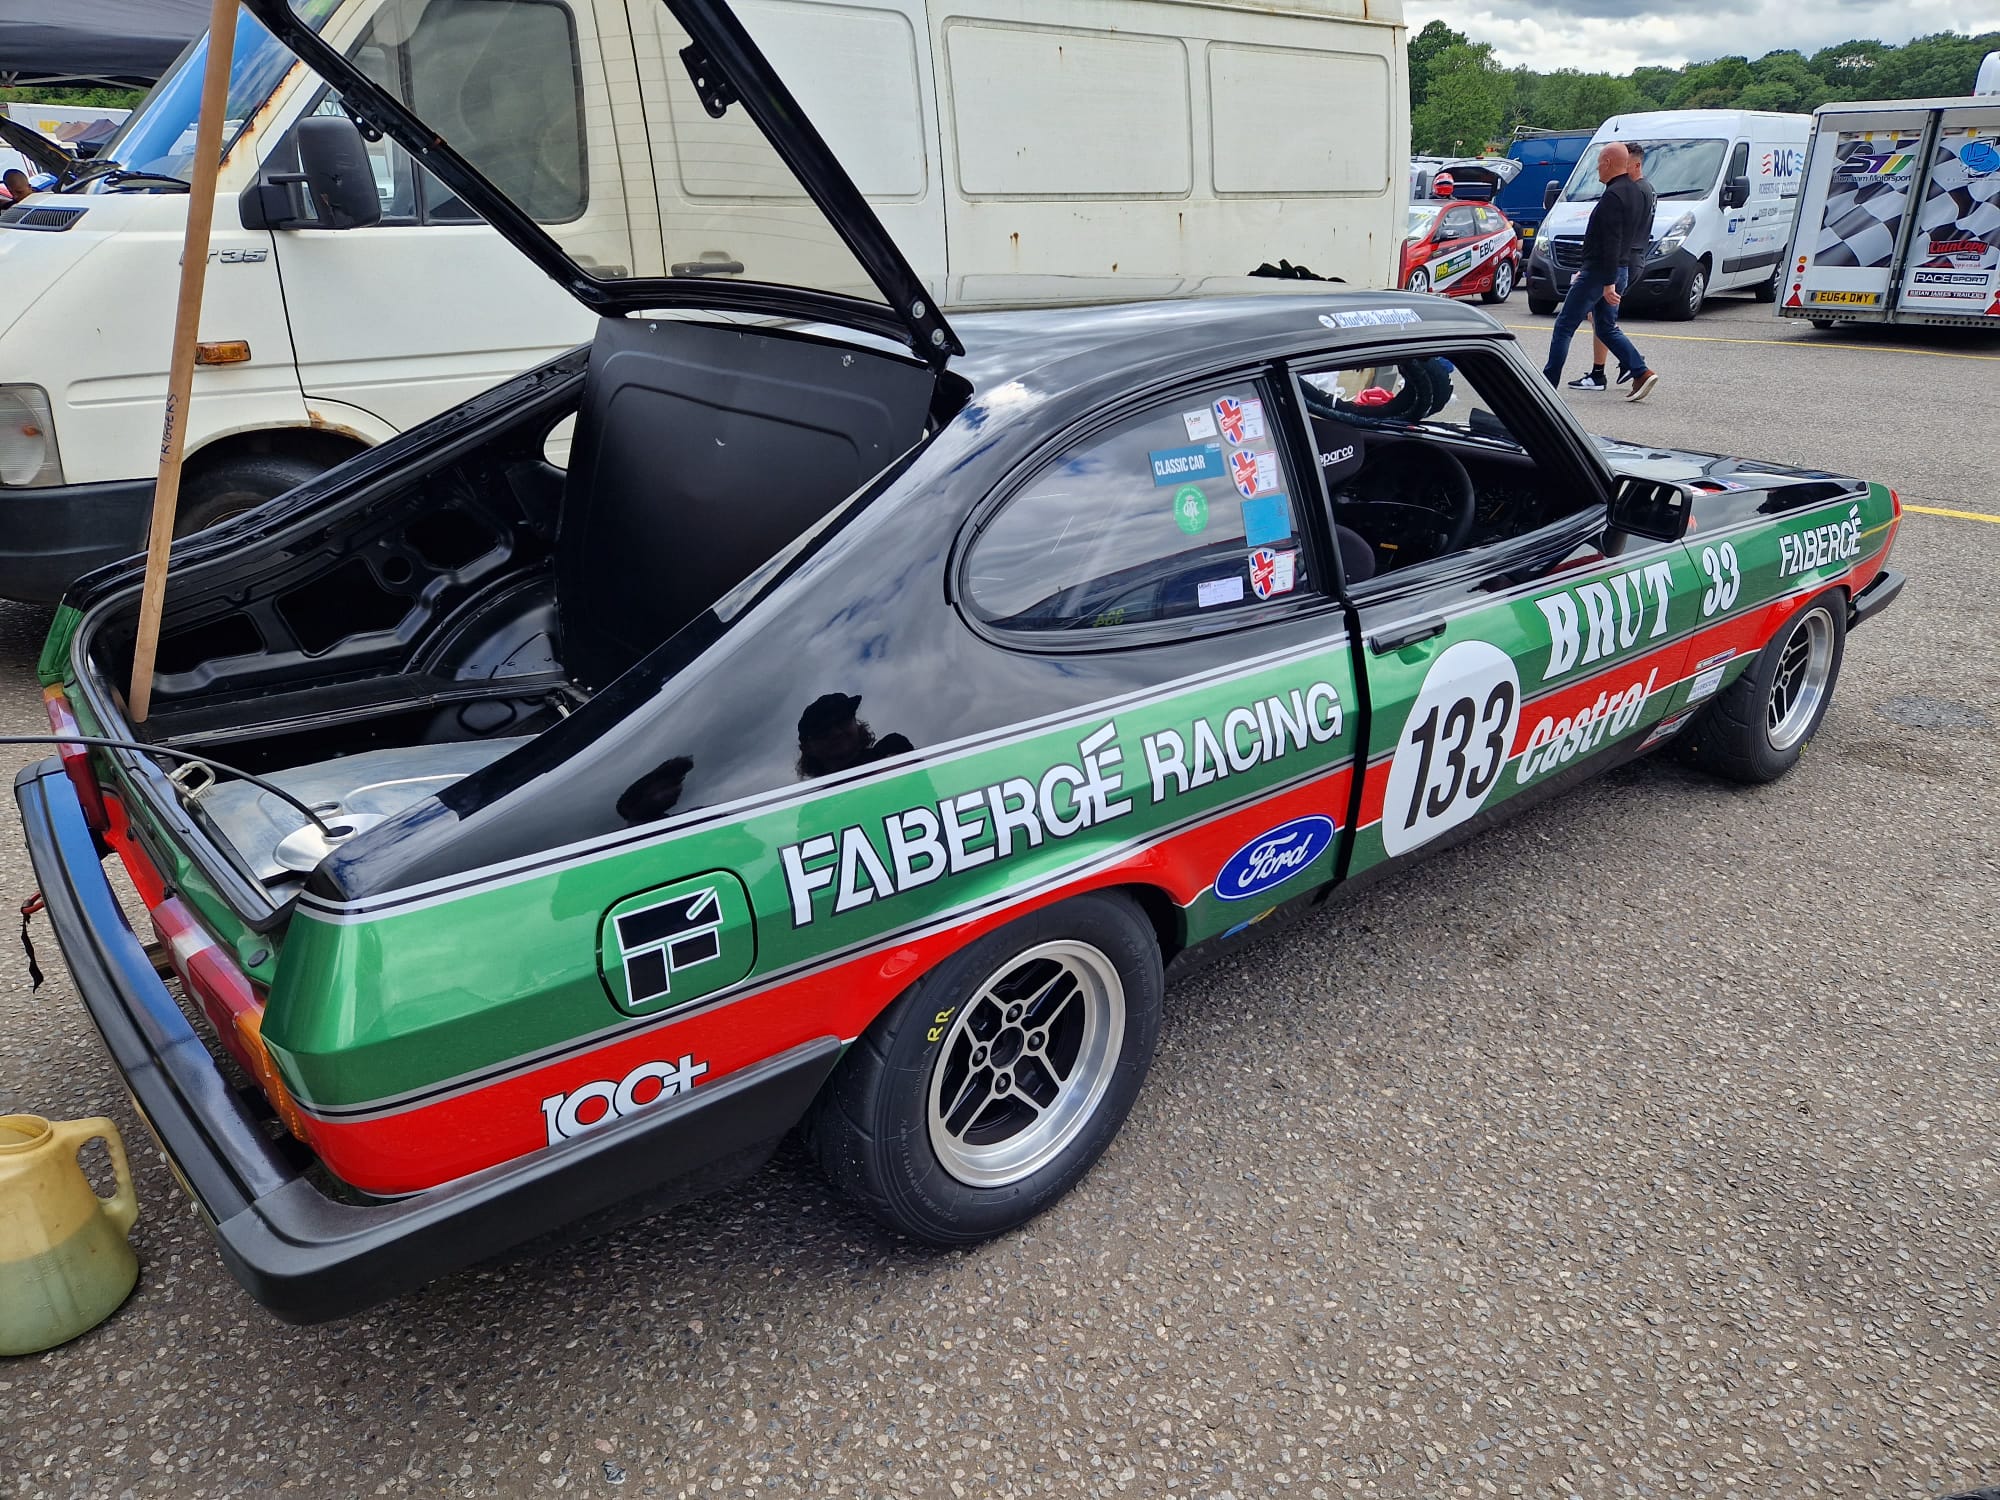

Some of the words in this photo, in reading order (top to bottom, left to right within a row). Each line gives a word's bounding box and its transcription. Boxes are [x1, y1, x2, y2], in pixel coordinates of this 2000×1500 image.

[1773, 149, 1793, 177] RAC
[1480, 240, 1494, 258] EBC
[1915, 273, 1951, 282] RACE
[1820, 292, 1846, 302] EU64
[1849, 293, 1870, 303] DWY
[1154, 457, 1189, 477] CLASSIC
[1188, 454, 1206, 471] CAR
[1778, 503, 1863, 578] FABERGÉ
[1701, 540, 1741, 617] 33
[1535, 560, 1675, 680] BRUT
[1404, 680, 1516, 830] 133
[1516, 667, 1660, 785] Castrol
[778, 719, 1134, 929] FABERGÉ
[1141, 681, 1344, 804] RACING
[1237, 829, 1310, 888] Ford
[927, 1006, 956, 1042] RR
